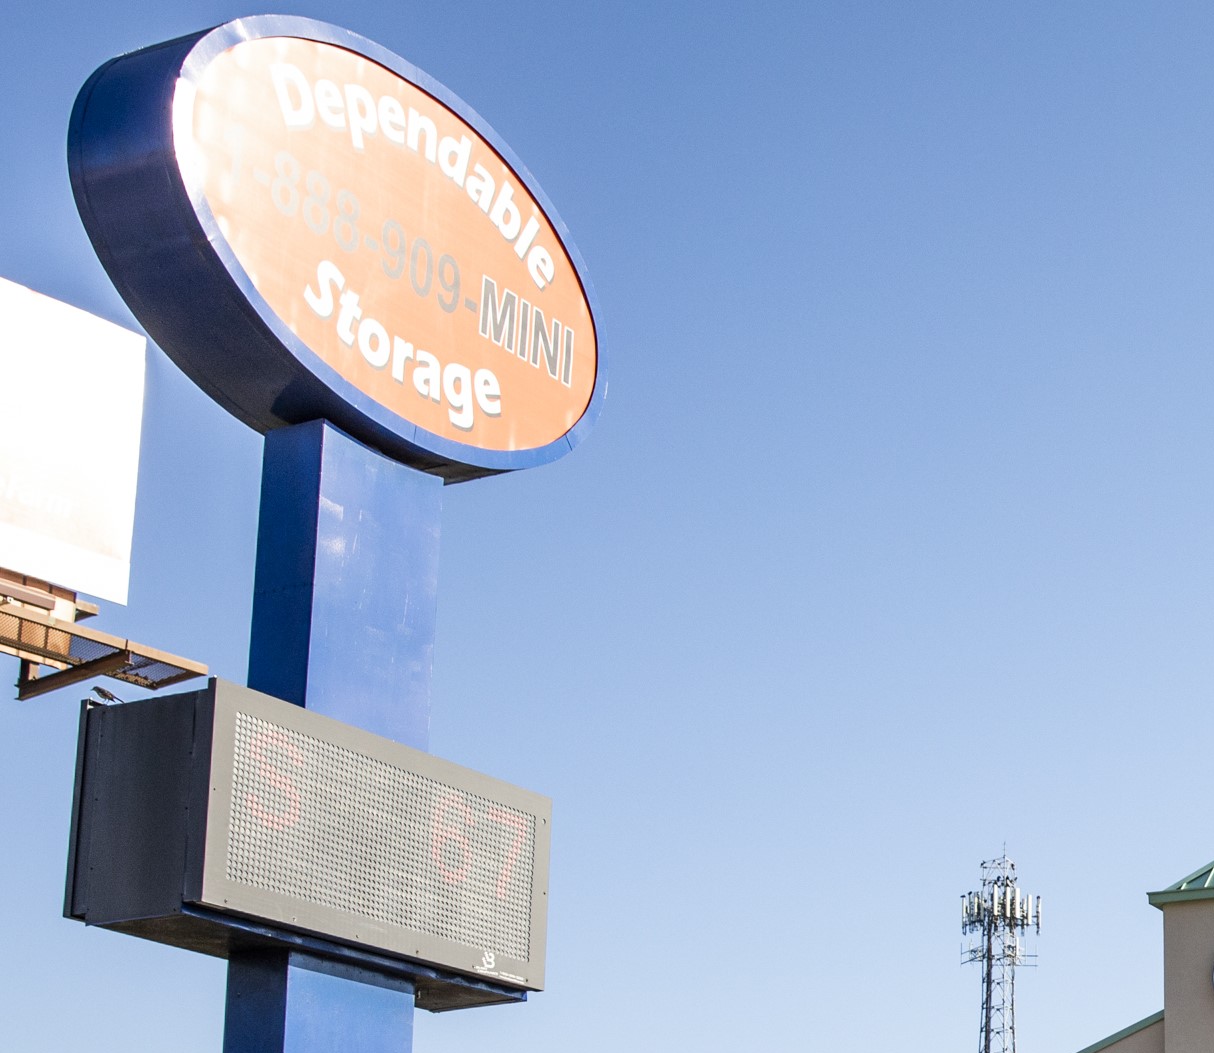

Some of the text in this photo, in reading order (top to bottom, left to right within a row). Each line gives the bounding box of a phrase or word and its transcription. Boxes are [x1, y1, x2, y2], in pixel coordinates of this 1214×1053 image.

[268, 62, 555, 291] Dependable
[303, 260, 502, 431] Storage
[431, 792, 528, 899] 67
